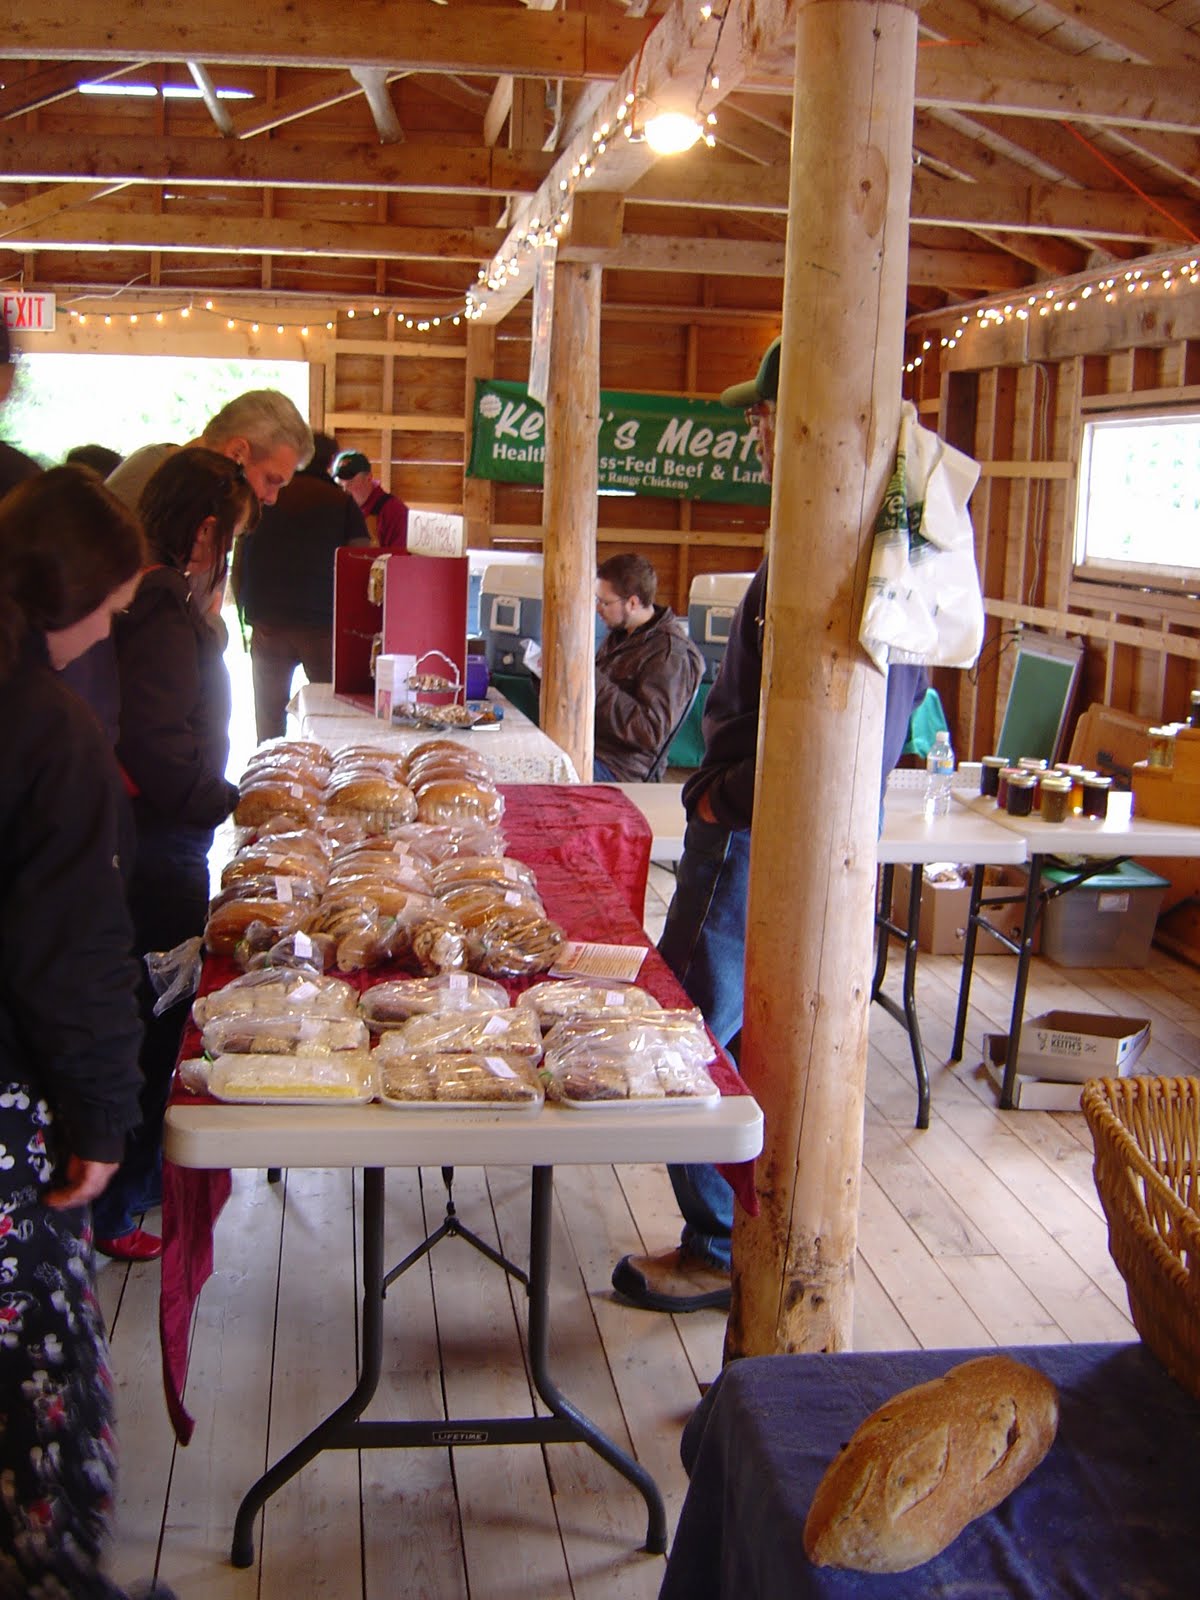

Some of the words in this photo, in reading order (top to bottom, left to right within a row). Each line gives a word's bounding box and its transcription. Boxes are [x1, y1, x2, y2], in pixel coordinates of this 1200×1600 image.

[4, 297, 45, 327] EXIT
[663, 459, 704, 478] Beef
[711, 464, 725, 480] &
[608, 472, 640, 486] Range
[642, 475, 689, 490] Chickens
[1051, 1039, 1082, 1051] KEITH'S
